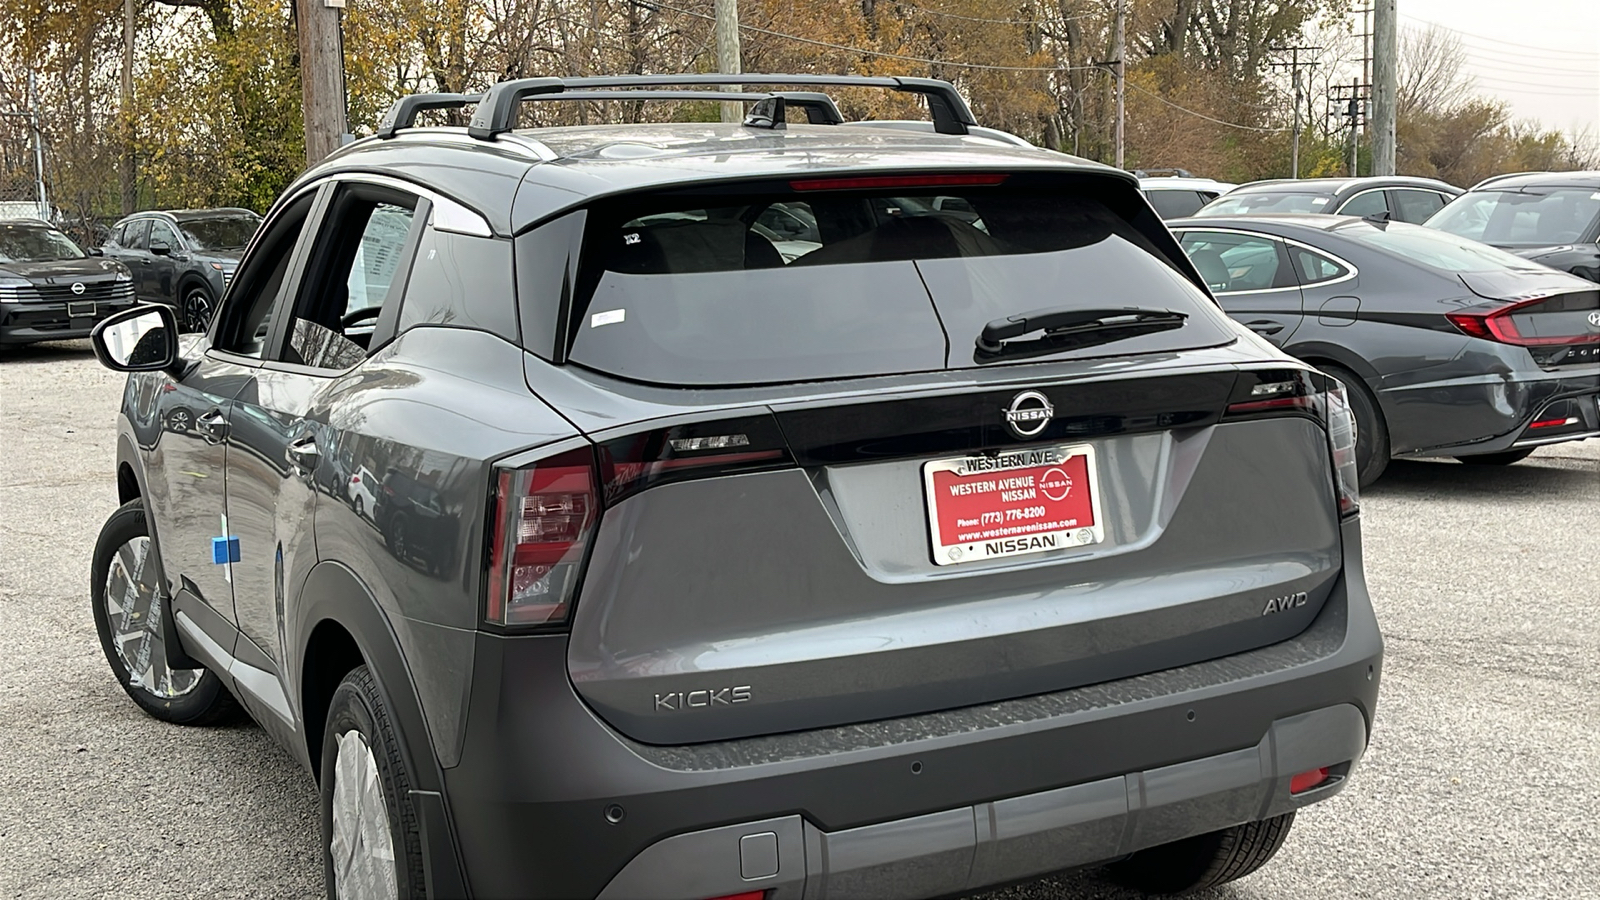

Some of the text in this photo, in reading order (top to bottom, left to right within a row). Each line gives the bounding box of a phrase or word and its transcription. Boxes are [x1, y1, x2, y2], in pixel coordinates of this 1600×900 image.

[1006, 409, 1054, 421] NISSAN
[966, 454, 1025, 472] WESTERN
[949, 476, 1035, 496] WESTERN AVENUE
[1039, 480, 1073, 489] NISSAN
[1001, 488, 1037, 503] NISSAN
[957, 506, 1046, 528] Phone: (773) 776-8200
[958, 518, 1077, 542] www.westernavenissan.com
[985, 534, 1056, 556] NISSAN
[1262, 591, 1308, 616] AWD
[653, 685, 752, 712] KICKS
